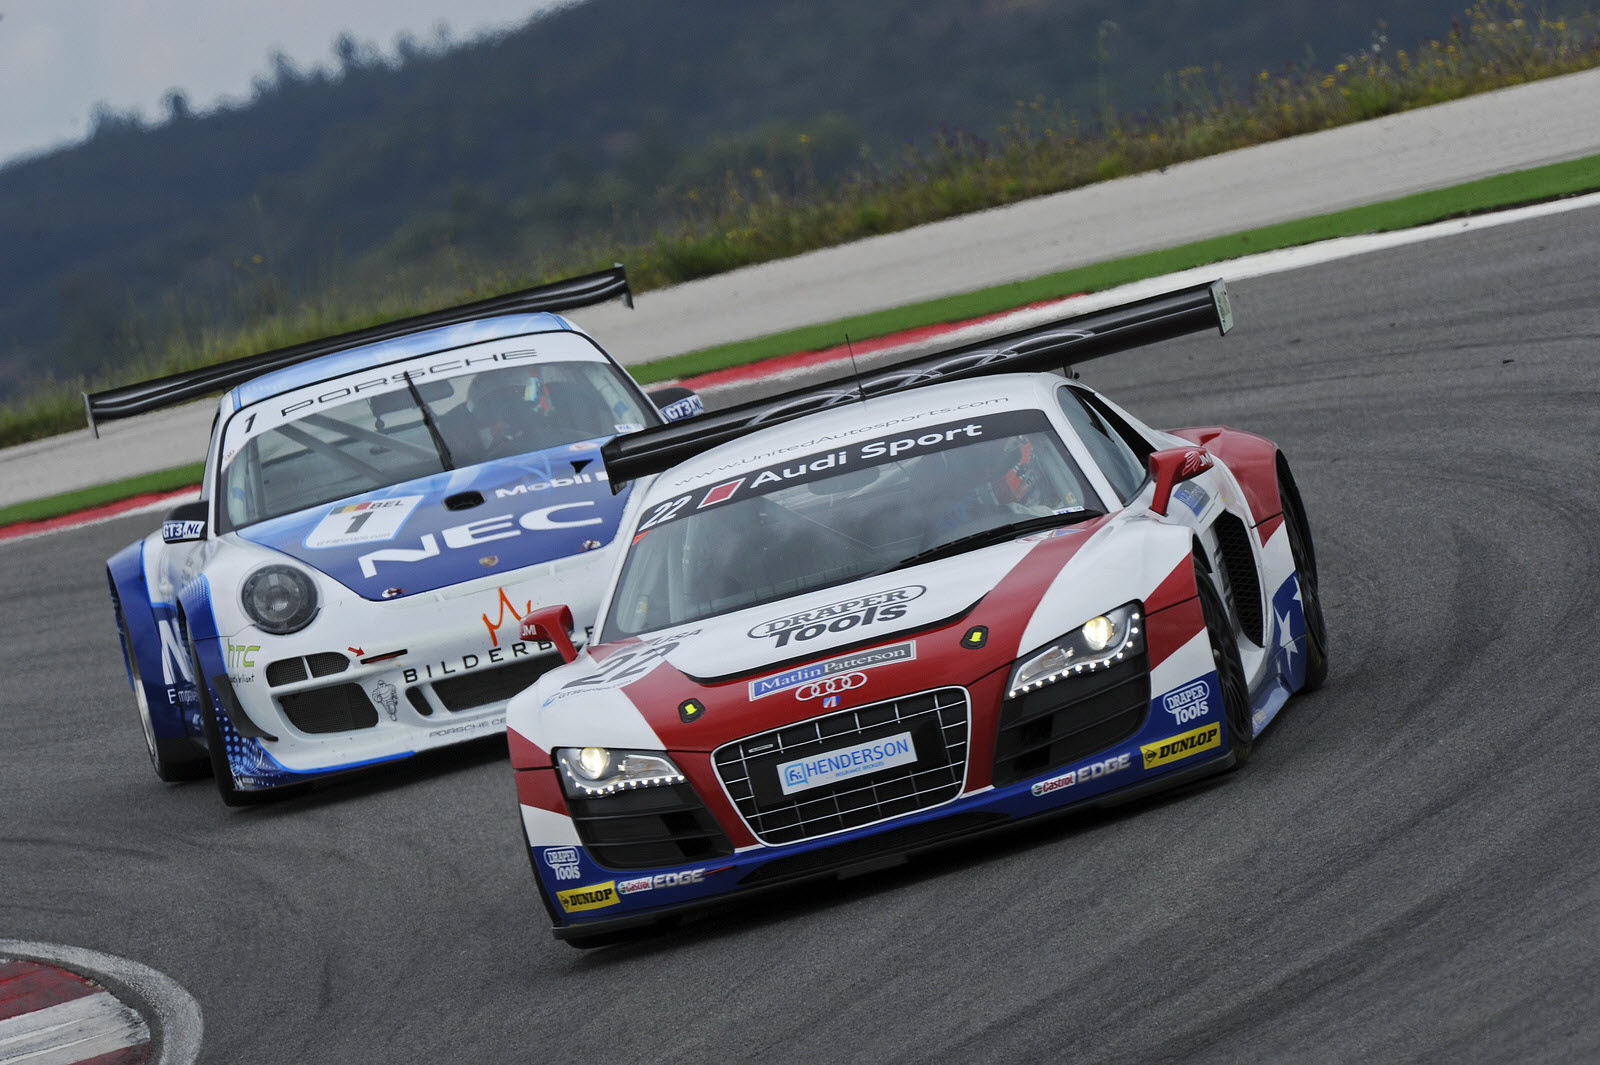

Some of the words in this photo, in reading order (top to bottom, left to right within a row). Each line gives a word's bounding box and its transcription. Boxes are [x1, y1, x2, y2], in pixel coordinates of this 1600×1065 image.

[281, 348, 538, 417] PORSCHE
[244, 412, 258, 434] 1
[674, 397, 1009, 487] www.UnitedAutosports.com
[749, 450, 848, 489] Audi
[860, 424, 983, 459] Sport
[495, 473, 592, 499] Mobil
[369, 498, 404, 511] BEL
[638, 495, 692, 532] 22
[162, 522, 202, 539] GT3.NL
[345, 510, 374, 535] 1
[357, 500, 603, 579] NEC
[766, 588, 909, 634] DRAPER
[403, 624, 595, 684] BILDERB
[560, 641, 681, 690] 22
[759, 647, 906, 693] MatlinPatterson
[1166, 684, 1205, 710] DRAPER
[1172, 700, 1210, 725] Tools
[805, 738, 910, 777] HENDERSON
[1158, 728, 1218, 759] DUNLOP
[1042, 774, 1074, 793] Castrol
[1076, 752, 1132, 783] EDGE
[547, 850, 578, 864] DRAPER
[553, 863, 581, 881] Tools
[625, 880, 651, 893] Castrol
[653, 867, 707, 889] EDGE
[570, 887, 613, 907] DUNLOP
